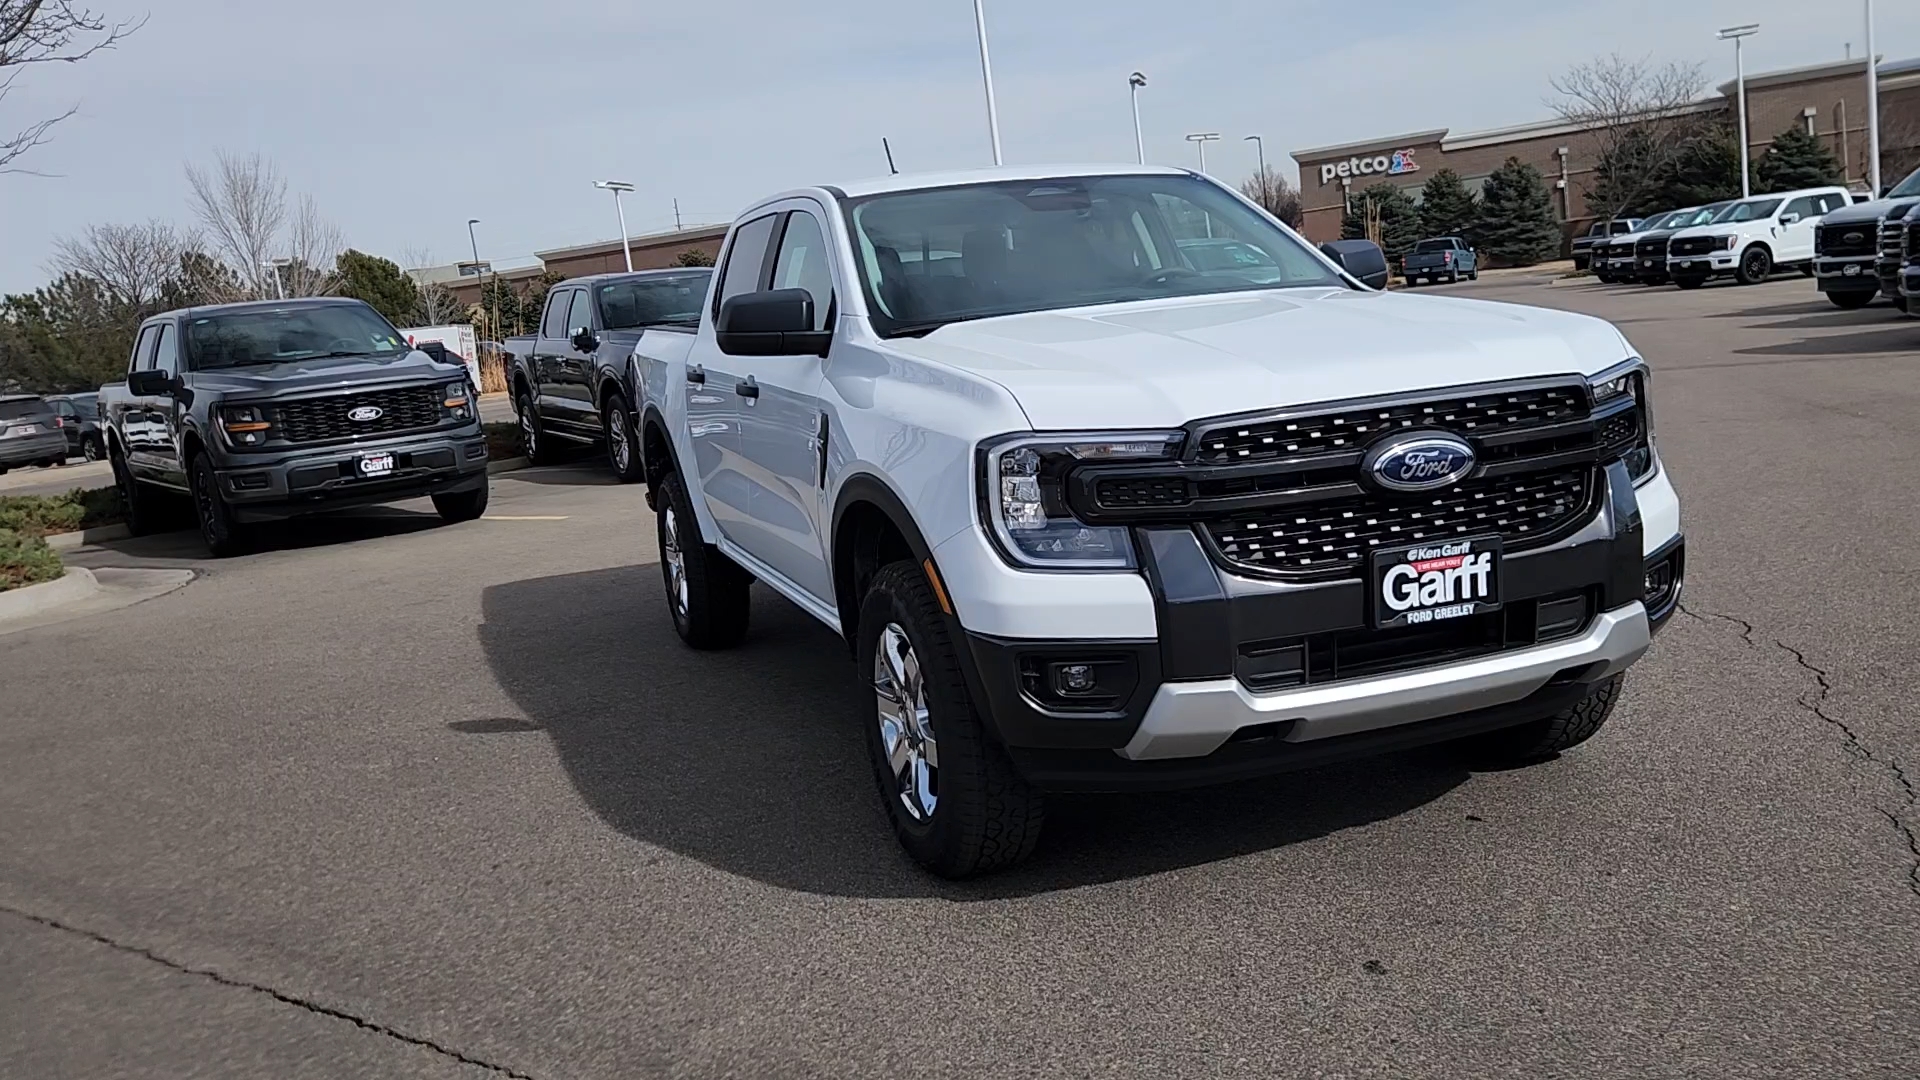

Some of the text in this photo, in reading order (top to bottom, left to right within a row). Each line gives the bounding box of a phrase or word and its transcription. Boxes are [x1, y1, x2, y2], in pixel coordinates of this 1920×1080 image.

[1321, 155, 1389, 184] petco
[360, 456, 393, 473] Garff
[1400, 450, 1453, 480] Ford
[1417, 541, 1471, 560] Ken Garff
[1382, 552, 1491, 611] Garff
[1407, 604, 1475, 624] FORD GREELEY
